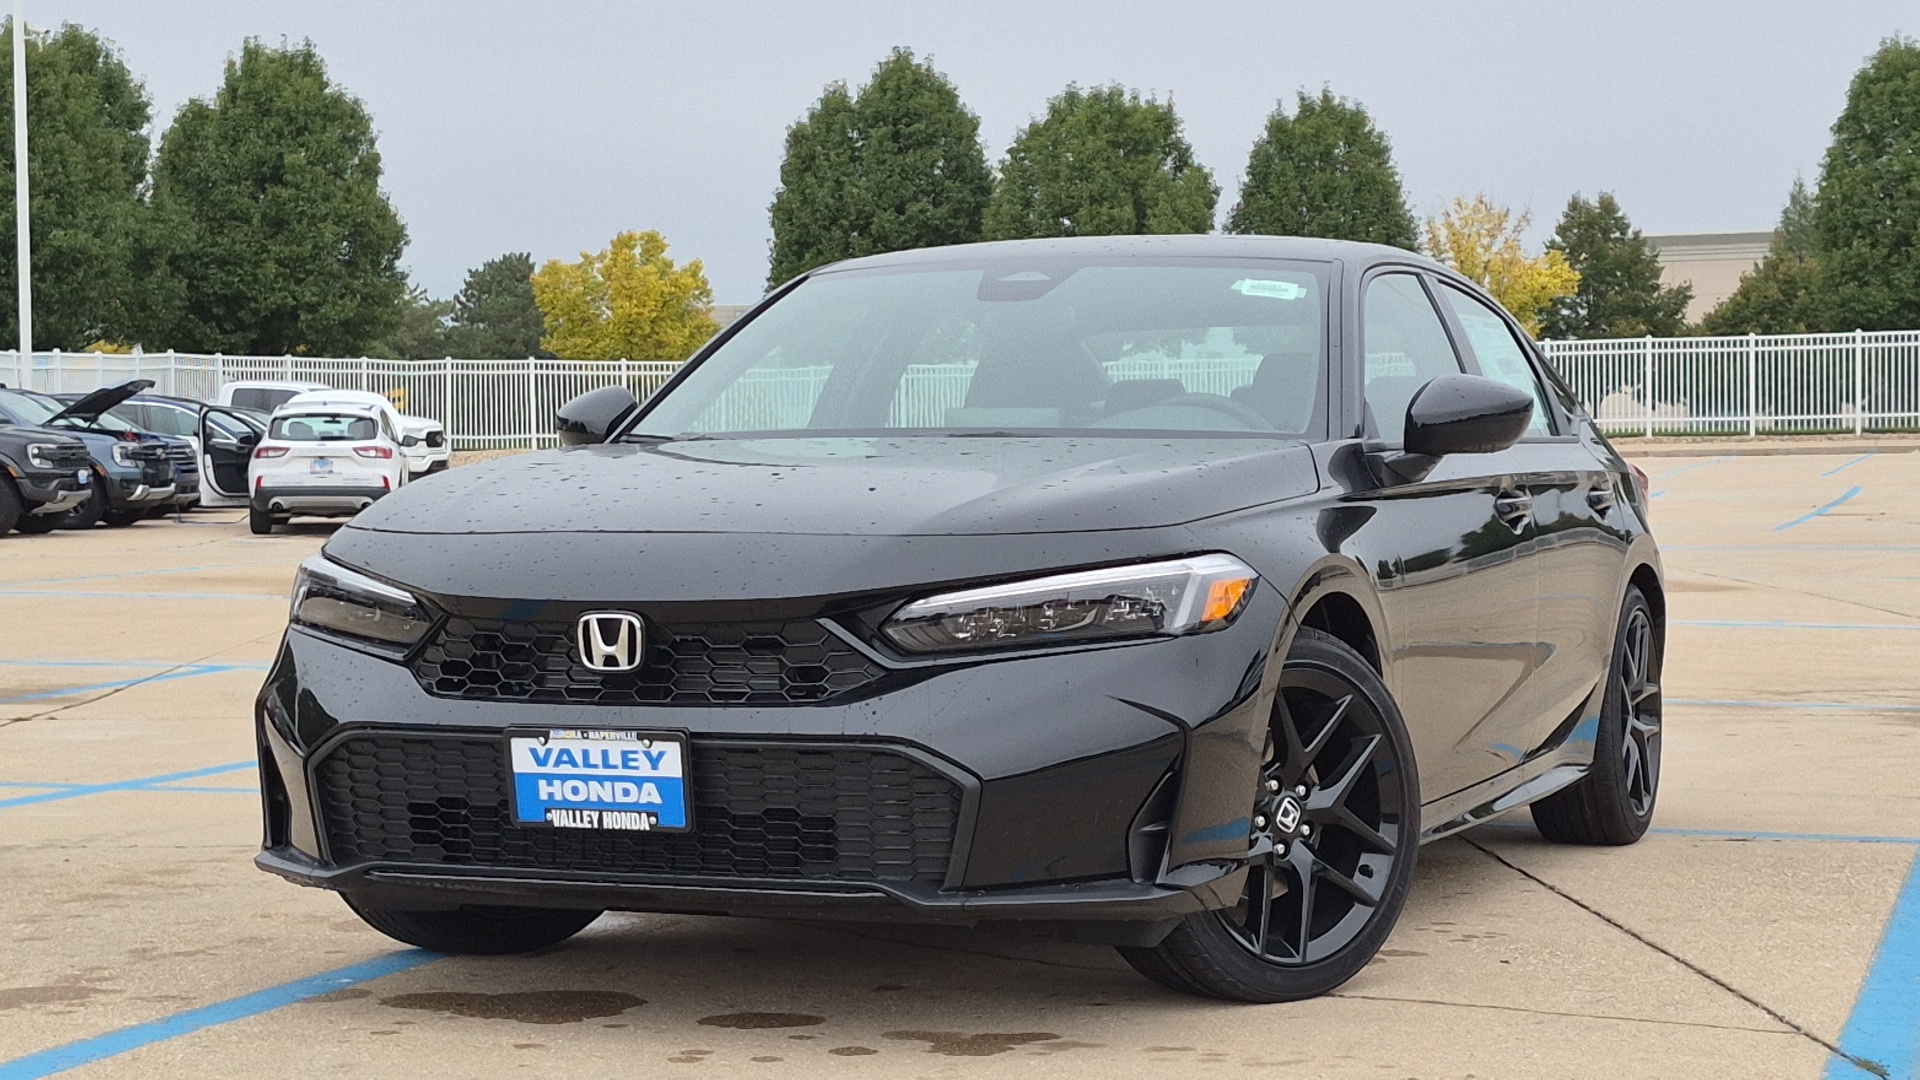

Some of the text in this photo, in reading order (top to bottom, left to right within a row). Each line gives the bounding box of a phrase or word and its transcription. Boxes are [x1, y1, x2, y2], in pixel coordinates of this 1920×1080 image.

[528, 747, 666, 771] VALLEY
[538, 779, 662, 804] HONDA
[551, 809, 650, 831] VALLEY HONDA
